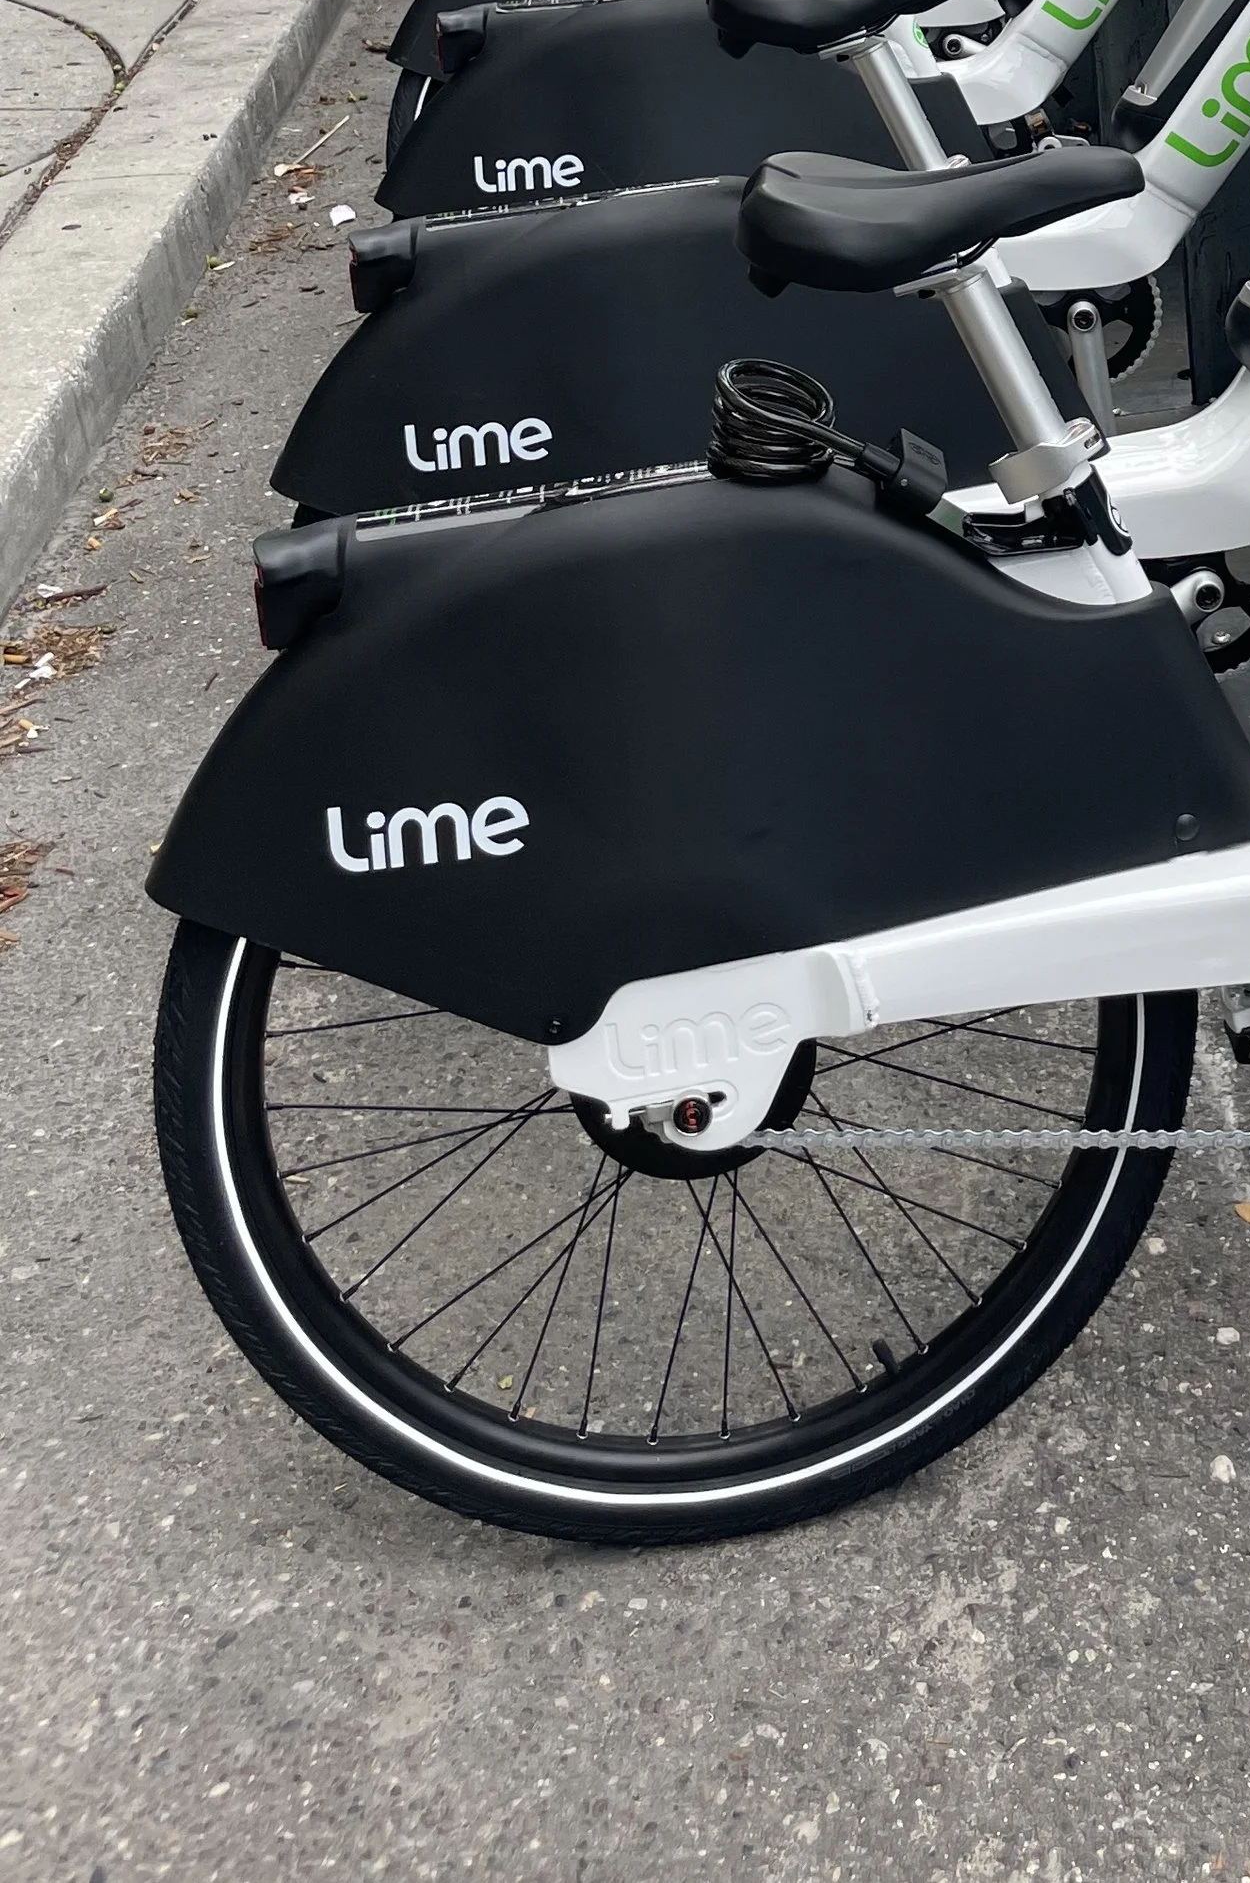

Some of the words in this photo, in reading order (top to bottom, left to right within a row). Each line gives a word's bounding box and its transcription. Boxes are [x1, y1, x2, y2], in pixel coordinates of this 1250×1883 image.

[473, 153, 586, 194] Lime
[403, 416, 555, 473] Lime
[325, 794, 532, 874] Lime
[604, 1001, 793, 1081] Lime
[900, 1423, 933, 1449] YANG
